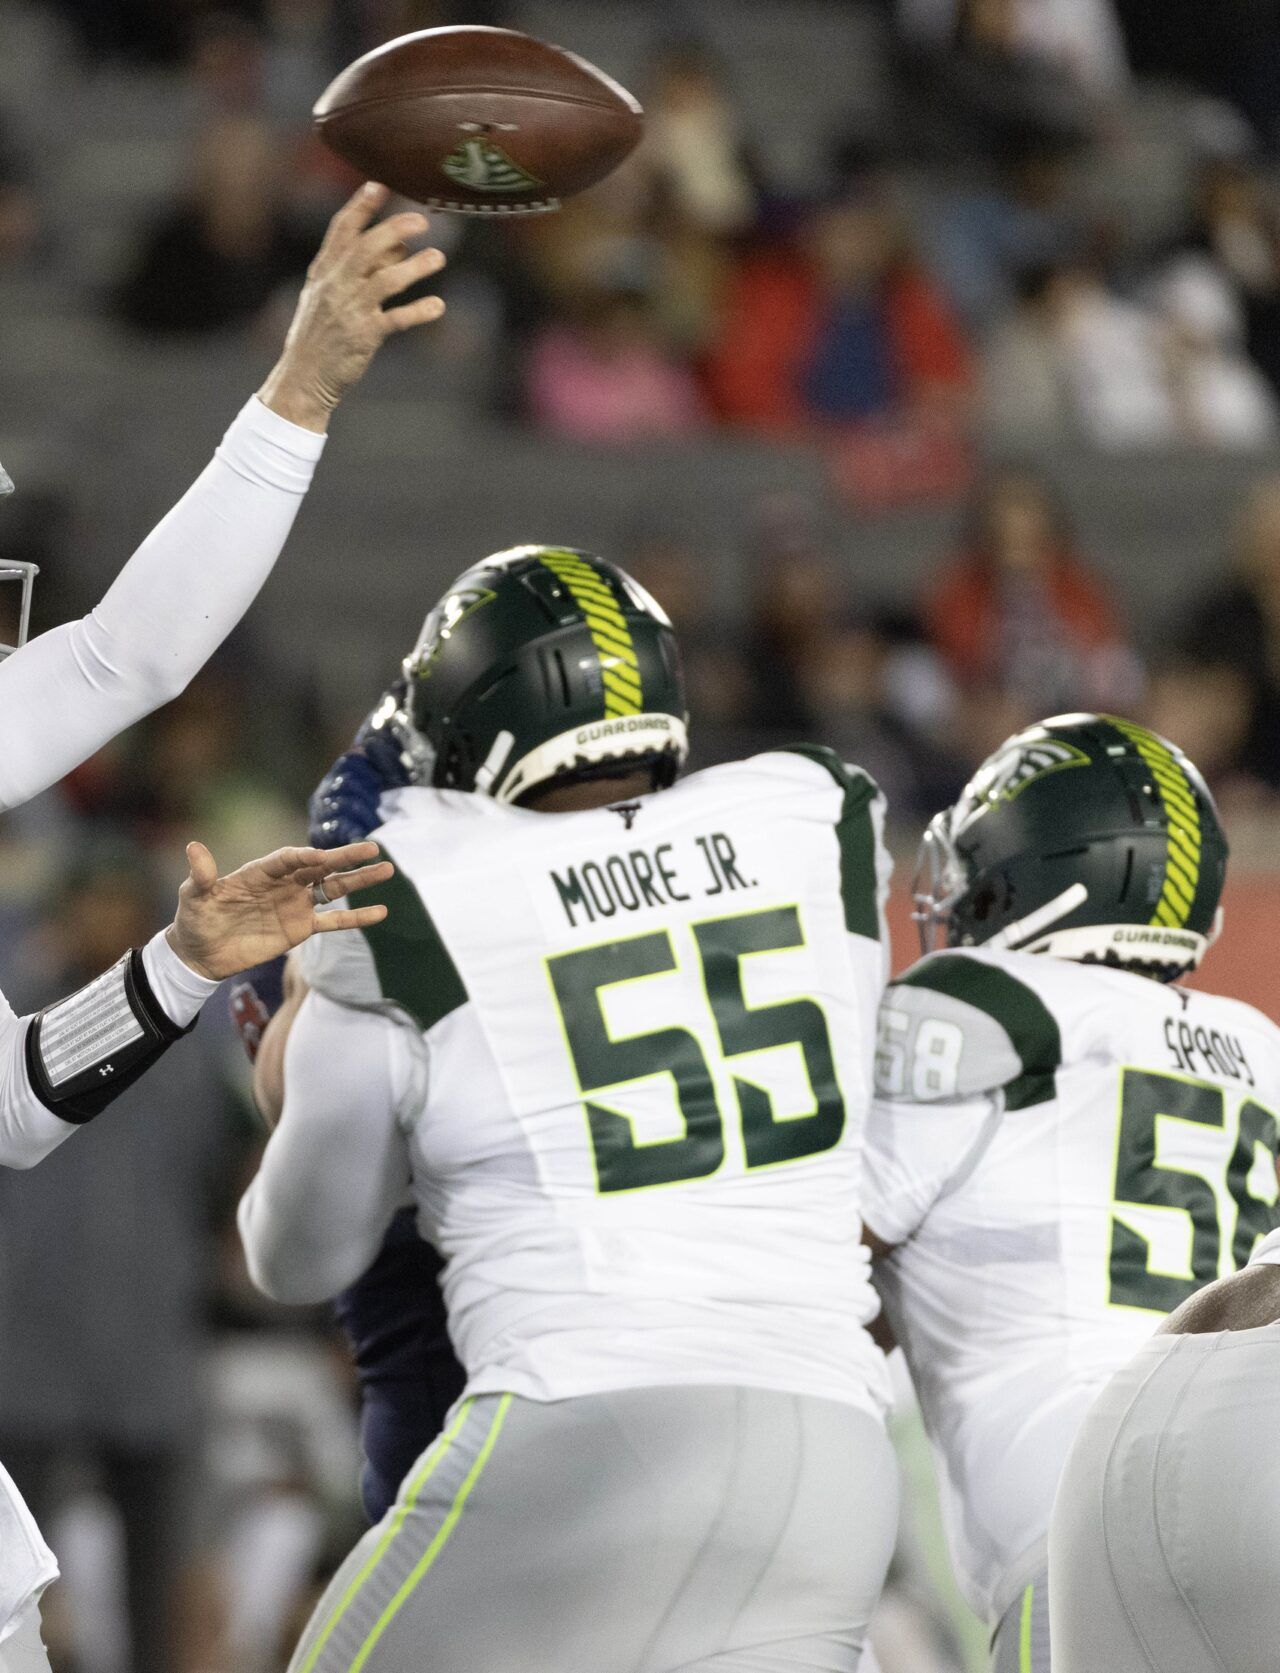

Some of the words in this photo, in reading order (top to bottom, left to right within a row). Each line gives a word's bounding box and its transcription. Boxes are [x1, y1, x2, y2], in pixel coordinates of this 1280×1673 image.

[576, 718, 671, 745] GUARDIANS
[549, 843, 691, 928] MOORE
[695, 832, 759, 896] JR.
[542, 904, 847, 1196] 55
[874, 1005, 963, 1101] 58
[1163, 1016, 1255, 1087] SPADY
